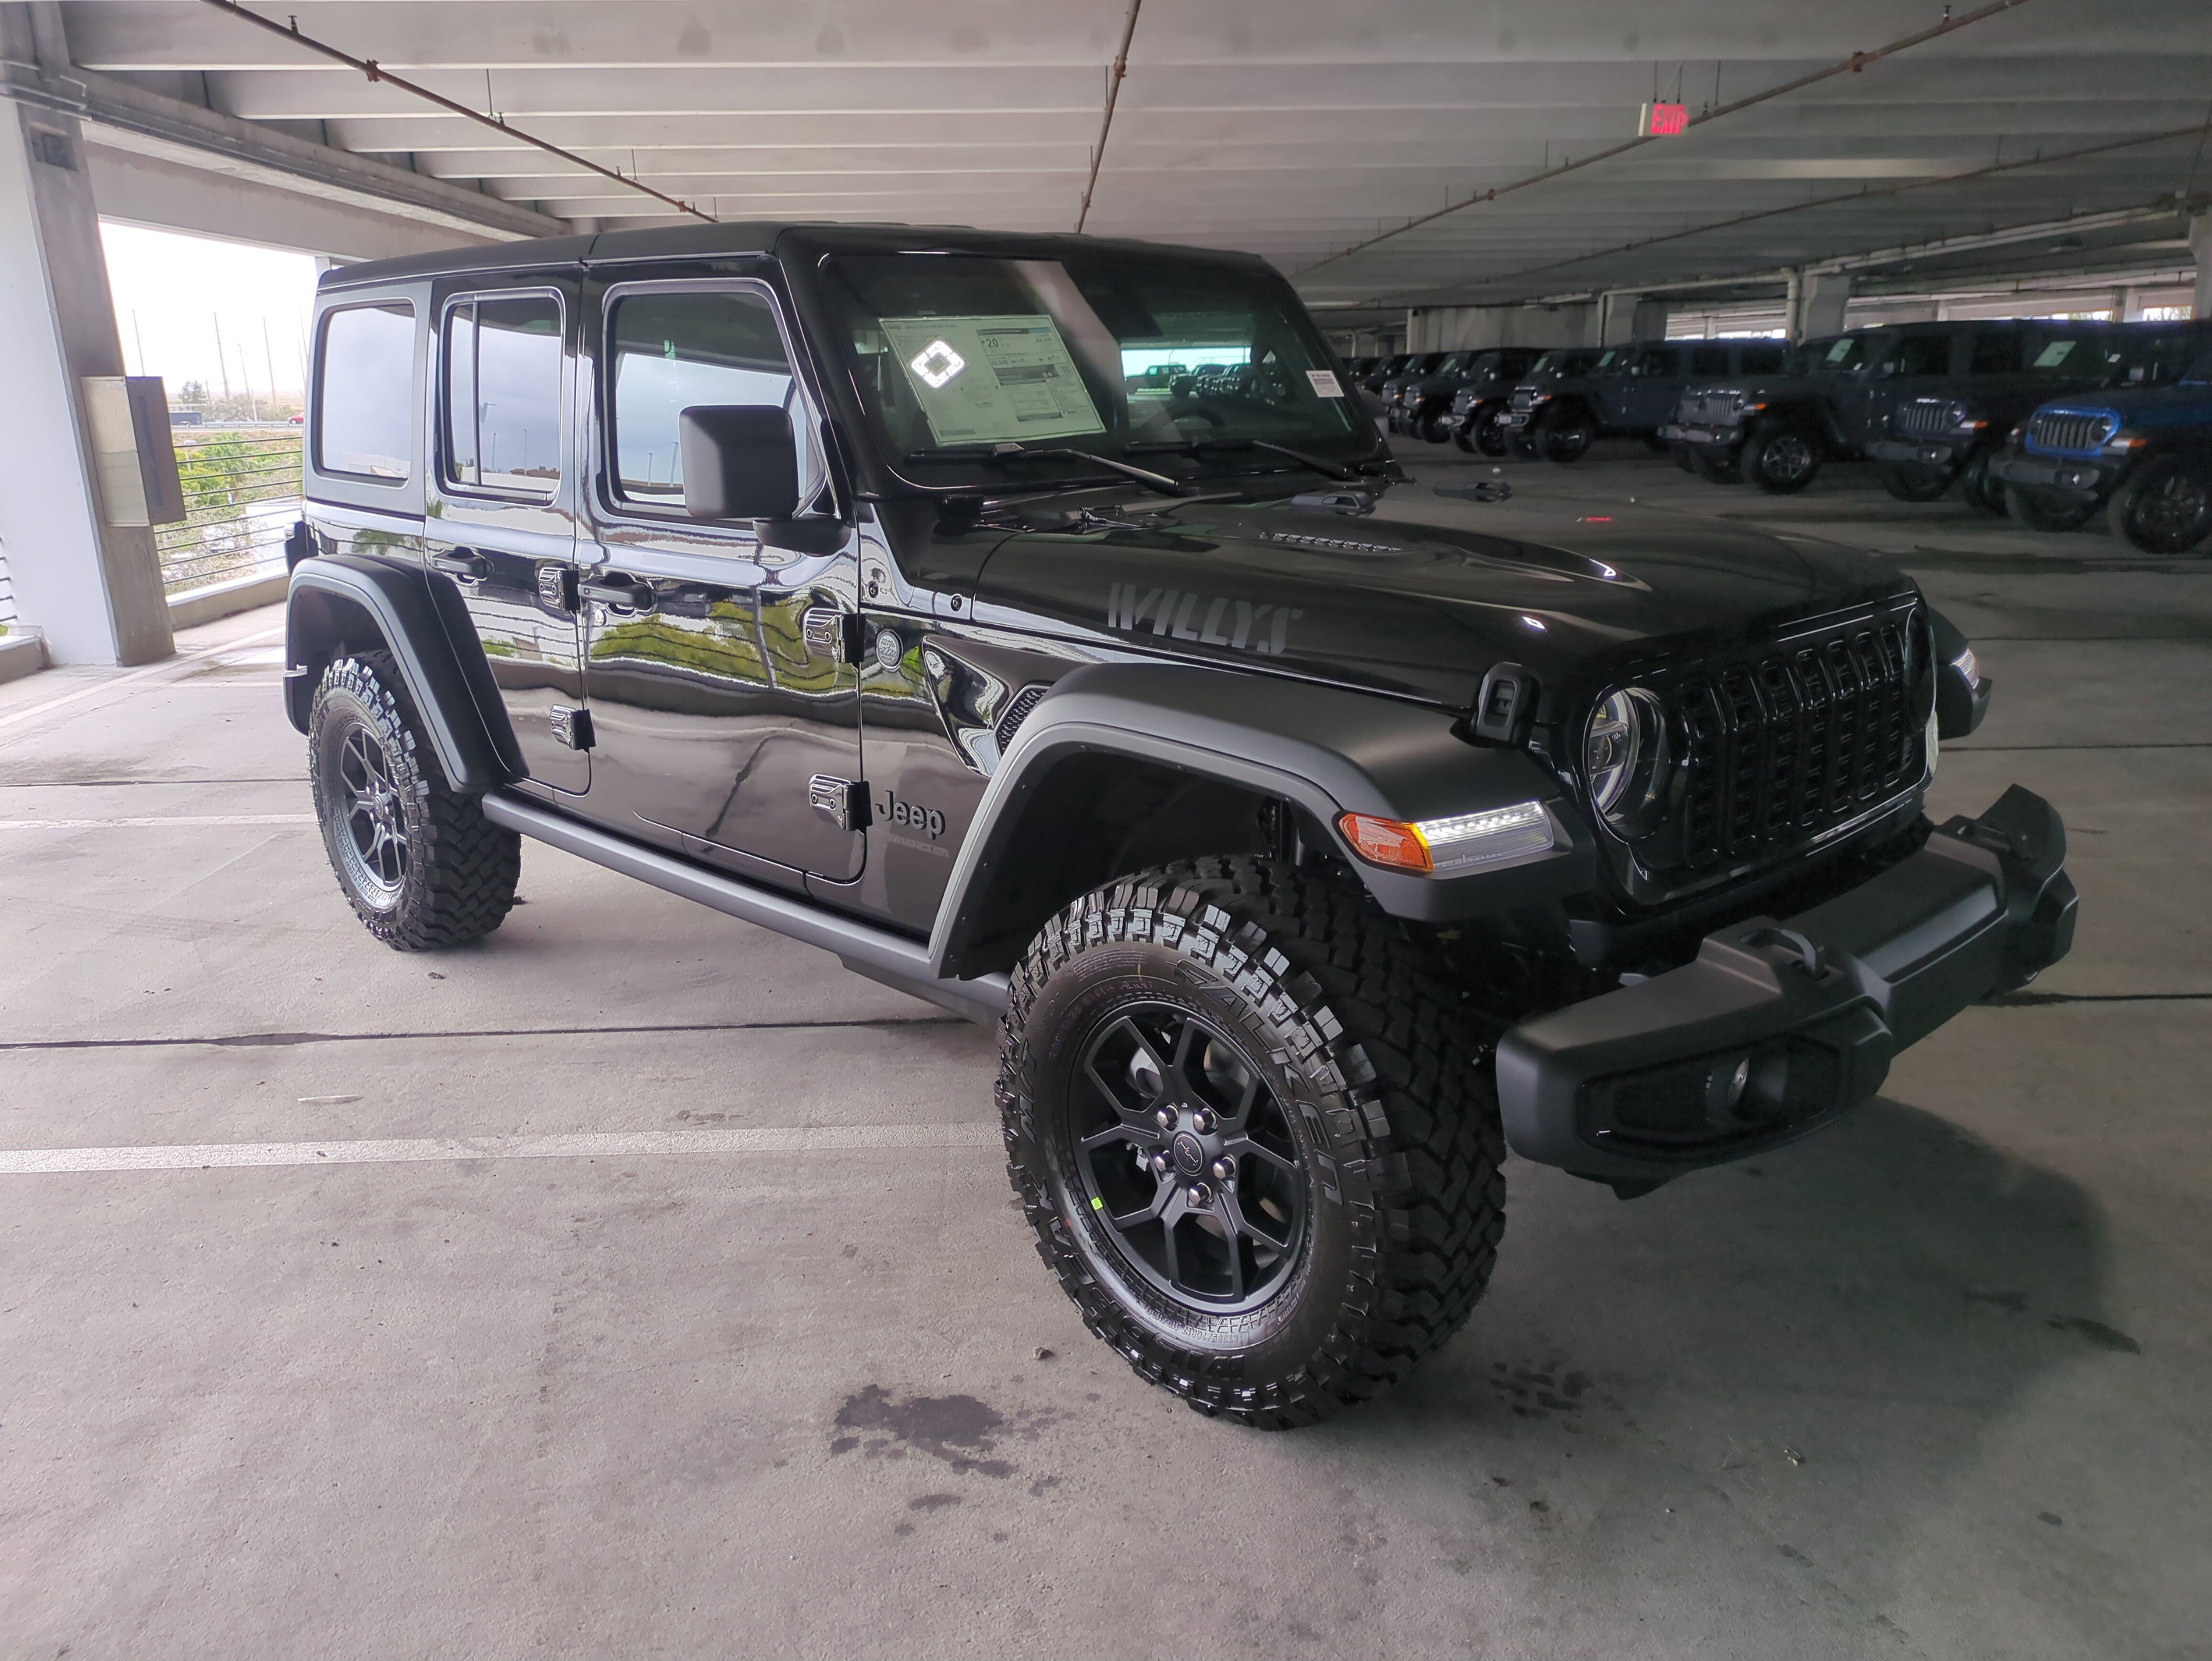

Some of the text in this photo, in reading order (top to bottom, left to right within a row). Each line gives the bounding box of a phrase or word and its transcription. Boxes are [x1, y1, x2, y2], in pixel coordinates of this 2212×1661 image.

[1650, 103, 1685, 134] EXIT
[986, 338, 999, 348] 20
[1108, 582, 1304, 655] WILLYS
[875, 789, 946, 840] Jeep
[1166, 958, 1344, 1206] FALKEN
